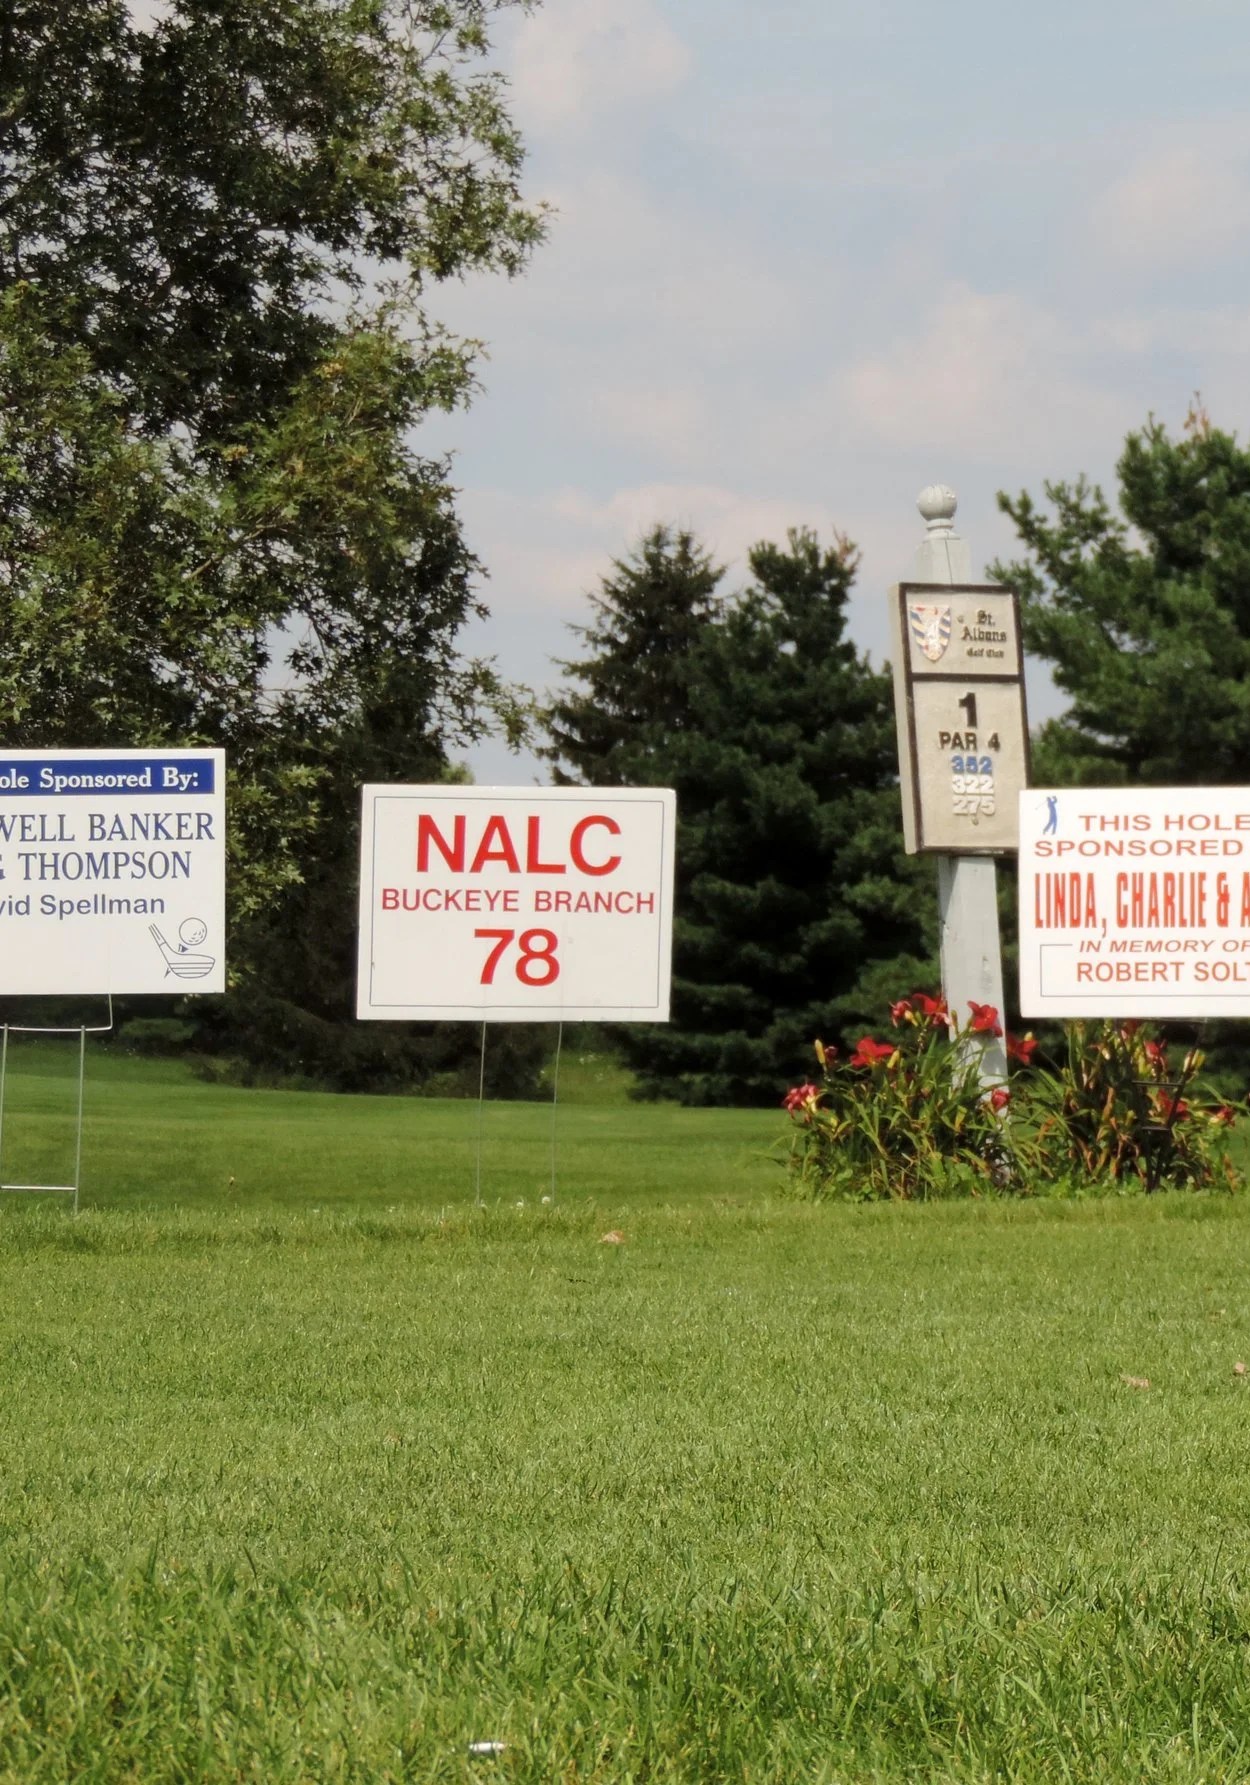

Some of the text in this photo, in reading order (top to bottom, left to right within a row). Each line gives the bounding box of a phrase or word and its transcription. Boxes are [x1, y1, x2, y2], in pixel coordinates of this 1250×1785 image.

[962, 626, 1007, 642] Albans
[958, 692, 978, 728] 1
[938, 731, 1001, 752] PAR 4
[951, 755, 993, 775] 352
[39, 766, 152, 792] Sponsored
[162, 766, 199, 791] By:
[951, 774, 995, 796] 322
[88, 812, 216, 842] BANKER
[1078, 814, 1152, 832] THIS
[416, 814, 622, 877] NALC
[1034, 839, 1244, 857] SPONSORED
[18, 851, 192, 881] THOMPSON
[40, 893, 165, 920] Spellman
[381, 888, 654, 914] BUCKEYE BRANCH
[1034, 872, 1107, 938] LINDA,
[1116, 871, 1207, 929] CHARLIE
[1216, 871, 1230, 928] &
[474, 928, 560, 987] 78
[1078, 939, 1103, 953] IN
[1109, 939, 1216, 953] MEMORY
[1076, 961, 1185, 983] ROBERT
